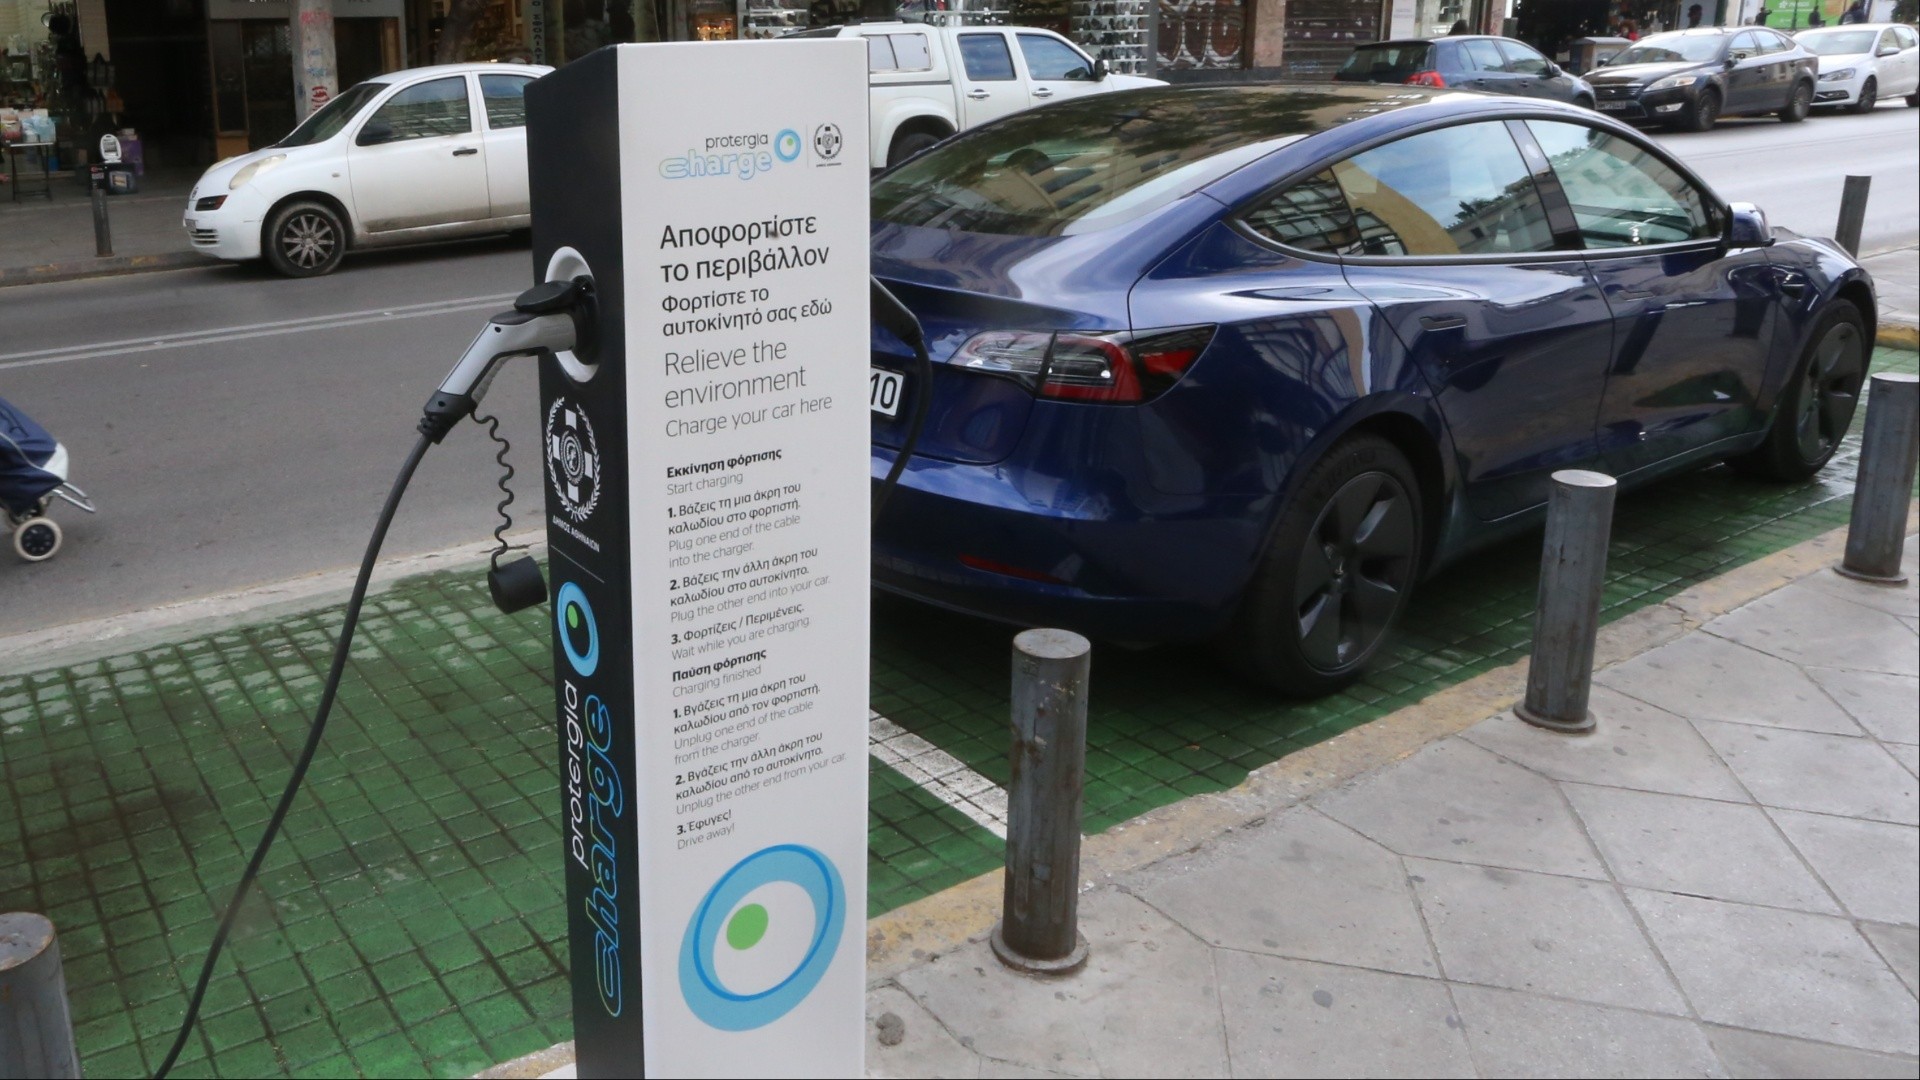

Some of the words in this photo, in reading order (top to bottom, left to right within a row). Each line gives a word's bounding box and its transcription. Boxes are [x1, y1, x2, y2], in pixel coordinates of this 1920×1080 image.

[705, 133, 769, 151] protergia
[659, 149, 772, 180] charge
[660, 215, 817, 250] Αποφορτίστε
[660, 263, 689, 283] το
[696, 246, 829, 281] περιβάλλον
[662, 290, 746, 313] Φορτίστε
[750, 288, 769, 301] το
[662, 308, 763, 336] αυτοκίνητό
[766, 306, 797, 322] σας
[801, 298, 832, 318] εδώ
[664, 347, 746, 376] Relieve
[752, 340, 787, 363] the
[665, 366, 806, 408] environment
[871, 373, 897, 409] 10
[665, 415, 727, 437] Charge
[732, 408, 767, 430] your
[772, 402, 795, 419] car
[800, 396, 832, 414] here
[667, 460, 724, 478] Εκκίνηση
[728, 449, 782, 470] φόρτισης
[667, 481, 693, 496] Start
[696, 472, 743, 490] charging
[668, 507, 676, 518] 1.
[679, 500, 716, 516] Βάζεις
[719, 498, 732, 509] τη
[734, 494, 751, 507] μια
[754, 487, 781, 502] άκρη
[783, 483, 801, 495] του
[668, 516, 724, 535] καλωδίου
[727, 512, 746, 523] στο
[668, 538, 693, 552] Plug
[696, 532, 717, 547] one
[719, 528, 740, 542] end
[742, 526, 752, 536] of
[755, 520, 772, 533] the
[774, 515, 801, 530] cable
[669, 555, 690, 568] into
[693, 549, 711, 563] the
[713, 541, 754, 559] charger.
[670, 579, 680, 590] 2.
[683, 571, 719, 588] Βάζεις
[722, 567, 740, 580] την
[743, 558, 770, 574] άλλη
[772, 552, 798, 568] άκρη
[800, 548, 818, 561] του
[670, 587, 724, 607] καλωδίου
[728, 581, 746, 594] στο
[670, 610, 694, 623] Plug
[697, 604, 714, 617] the
[717, 597, 744, 612] other
[747, 592, 767, 604] end
[769, 586, 788, 598] into
[791, 581, 811, 594] your
[671, 634, 681, 645] 3.
[683, 620, 737, 641] Φορτίζεις
[672, 647, 694, 660] Wait
[698, 639, 724, 654] while
[728, 634, 746, 647] you
[749, 629, 764, 641] are
[672, 665, 711, 682] Παύση
[713, 649, 767, 672] φόρτισης
[672, 677, 720, 698] Charging
[723, 664, 762, 684] finished
[673, 708, 681, 719] 1.
[684, 698, 725, 716] Βγάζεις
[728, 693, 739, 704] τη
[742, 688, 758, 701] μια
[760, 680, 786, 694] άκρη
[789, 673, 806, 685] του
[674, 714, 727, 735] καλωδίου
[729, 704, 749, 719] από
[752, 700, 769, 712] τον
[674, 732, 712, 750] Unplug
[715, 725, 735, 738] one
[737, 718, 755, 732] end
[758, 713, 768, 725] of
[770, 707, 786, 720] the
[788, 701, 814, 716] cable
[674, 752, 699, 765] from
[702, 744, 718, 757] the
[676, 775, 685, 785] 2.
[688, 764, 728, 782] Βγάζεις
[731, 756, 748, 769] την
[751, 747, 776, 762] άλλη
[778, 738, 803, 753] άκρη
[806, 732, 823, 744] του
[564, 679, 589, 870] protergia
[676, 778, 728, 800] καλωδίου
[730, 772, 750, 786] από
[753, 767, 764, 776] το
[676, 796, 713, 815] Unplug
[716, 790, 732, 803] the
[735, 781, 760, 796] other
[763, 774, 782, 787] end
[784, 767, 807, 780] from
[809, 761, 829, 774] your
[677, 825, 686, 835] 3.
[687, 809, 732, 831] Έφυγες!
[678, 835, 703, 850] Drive
[707, 822, 735, 840] away!
[585, 693, 623, 1017] charge
